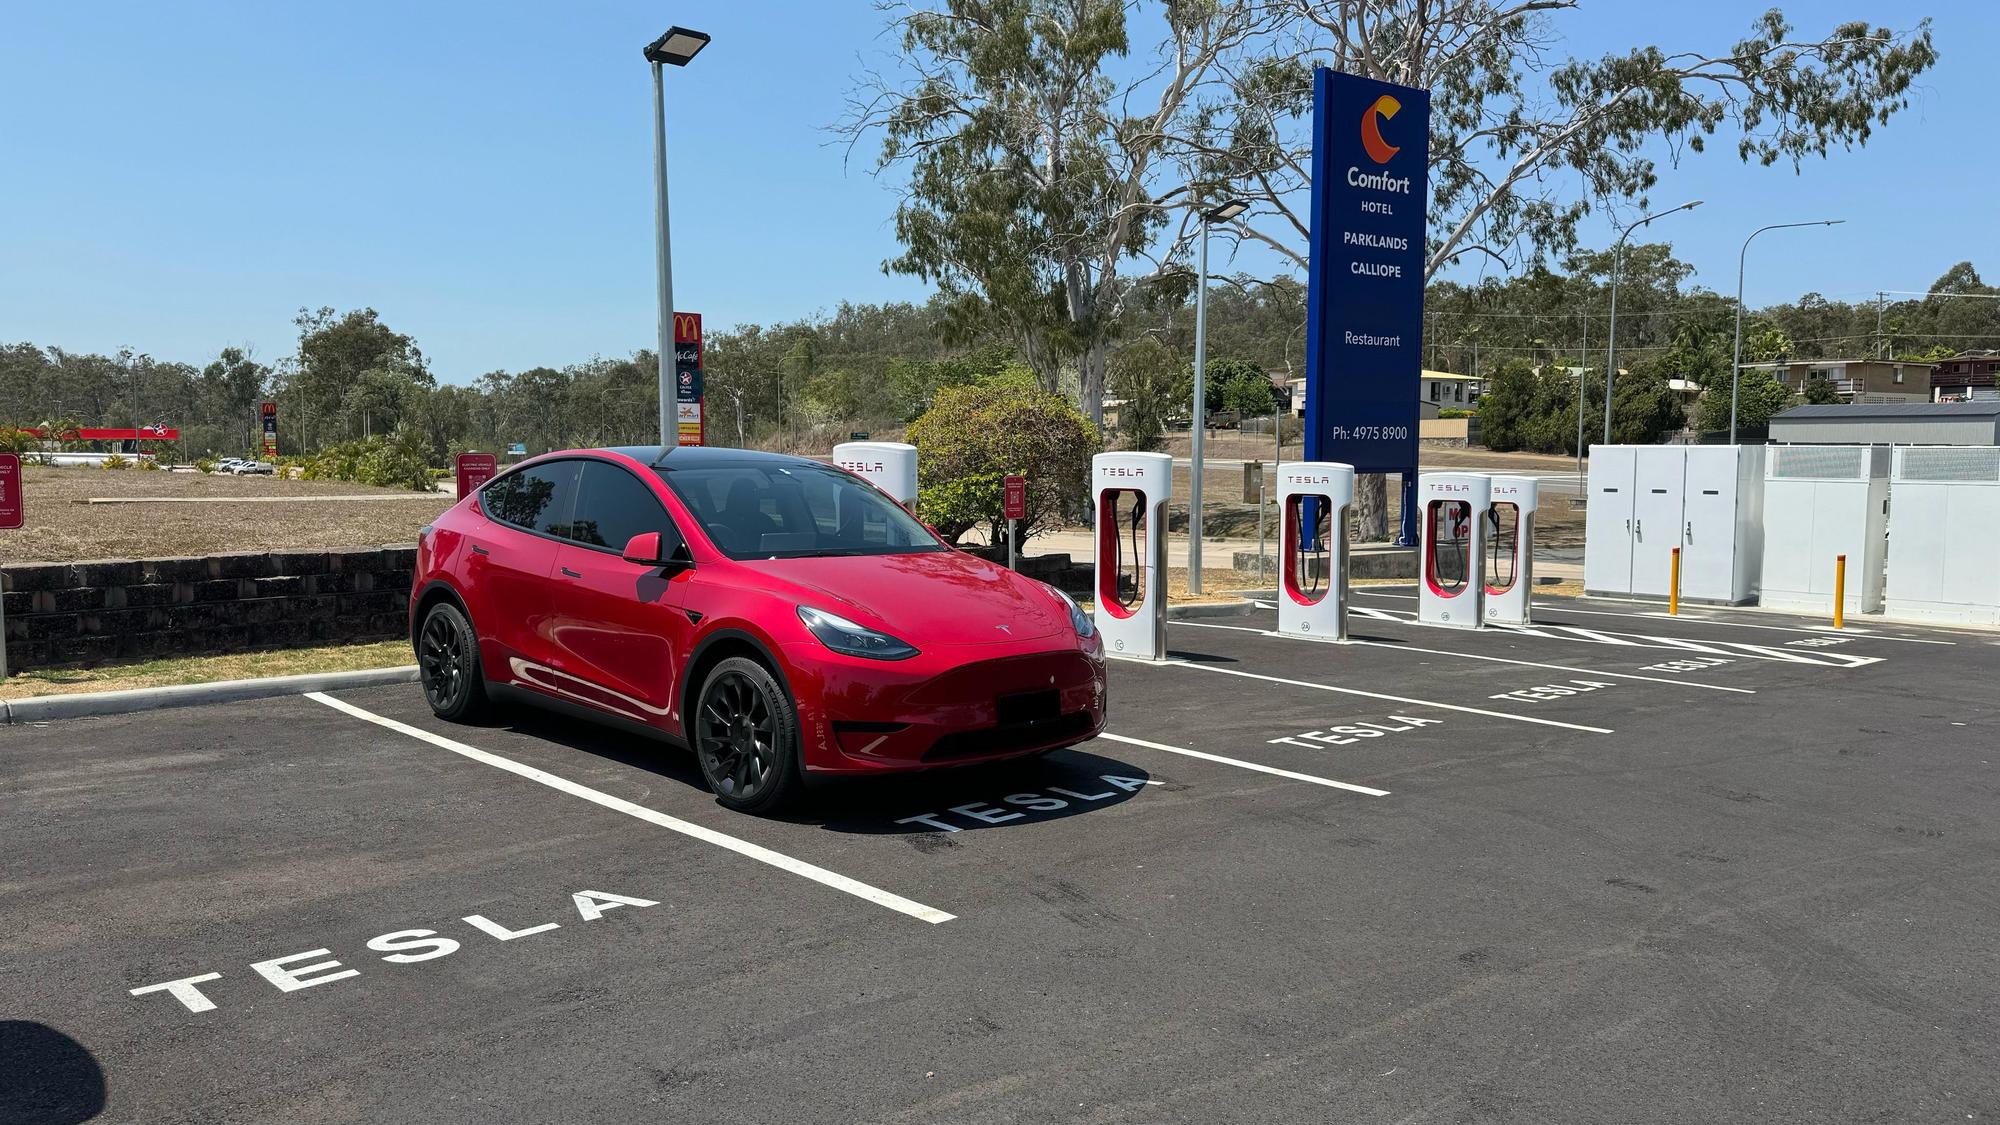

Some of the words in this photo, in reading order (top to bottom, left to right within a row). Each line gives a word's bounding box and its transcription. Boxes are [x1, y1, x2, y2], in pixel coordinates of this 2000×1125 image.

[1347, 166, 1410, 194] Comfort
[1361, 201, 1393, 215] HOTEL
[1343, 231, 1408, 251] PARKLANDS
[1351, 261, 1401, 278] CALLIOPE
[1345, 330, 1400, 347] Restaurant
[1333, 426, 1350, 440] Ph:
[1353, 426, 1379, 440] 4975
[1382, 426, 1407, 440] 8900
[841, 462, 883, 472] TESLA
[1102, 468, 1144, 476] TESLA
[1288, 476, 1329, 484] TESLA
[1638, 657, 1736, 673] TESLA
[1488, 680, 1617, 702] TESLA
[1267, 714, 1443, 749] TESLA
[894, 774, 1166, 833] TESLA
[129, 890, 661, 1013] TESLA
